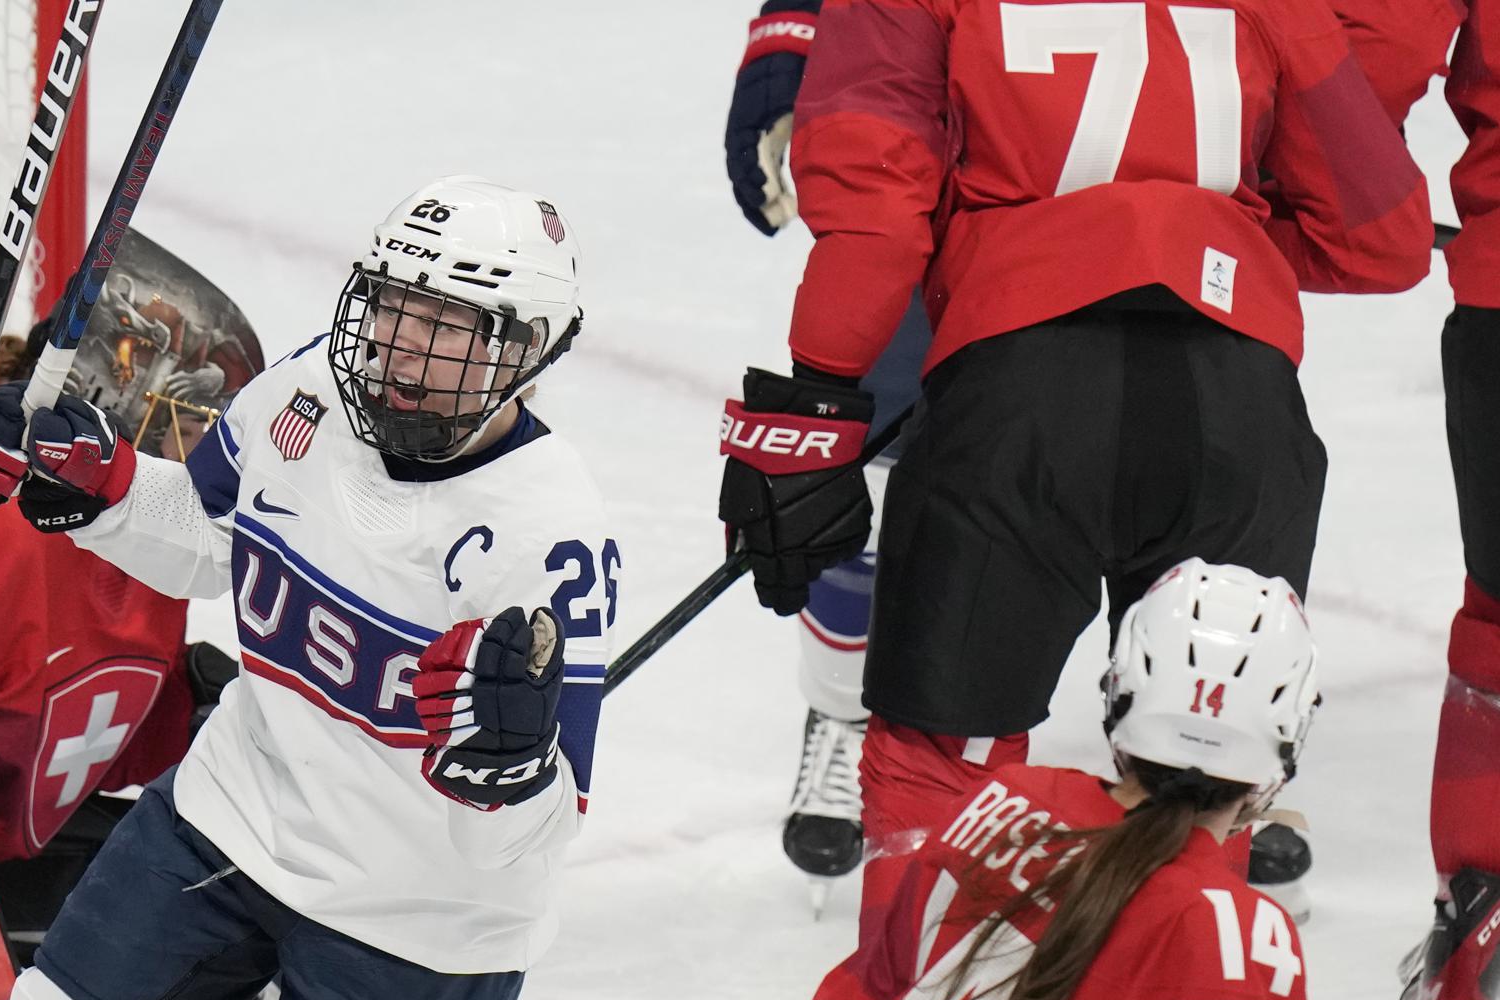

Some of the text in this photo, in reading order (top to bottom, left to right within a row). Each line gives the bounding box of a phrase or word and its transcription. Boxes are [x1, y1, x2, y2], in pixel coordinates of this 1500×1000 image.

[1000, 2, 1238, 198] 71
[91, 111, 173, 269] TEAM USA
[410, 199, 452, 223] 26
[385, 237, 443, 262] CCM
[293, 396, 319, 422] USA
[39, 447, 69, 461] CCM
[719, 412, 840, 459] AUER
[37, 512, 85, 527] CCM
[444, 524, 495, 593] C
[1188, 678, 1226, 718] 14
[1202, 888, 1302, 998] 14
